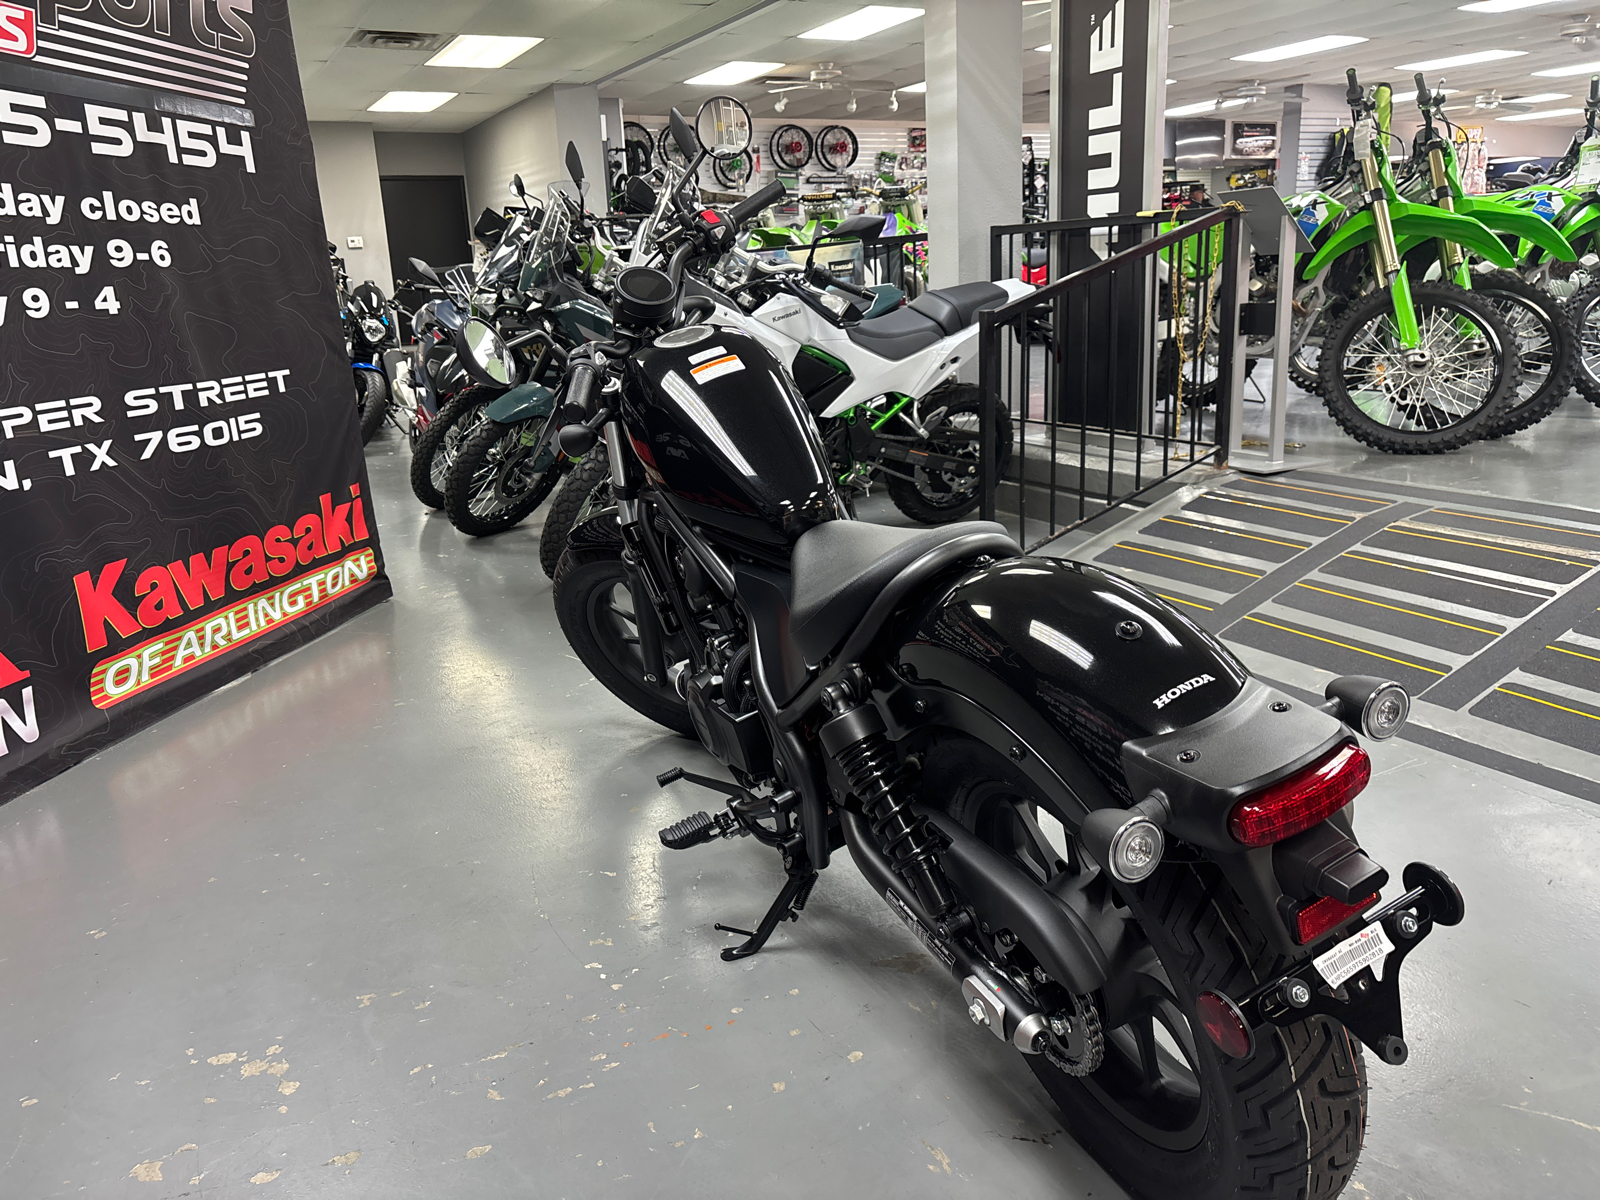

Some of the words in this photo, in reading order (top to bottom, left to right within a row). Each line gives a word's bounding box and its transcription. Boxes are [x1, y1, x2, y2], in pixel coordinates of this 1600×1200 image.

[0, 89, 256, 174] 5-5454
[80, 191, 202, 226] closed
[106, 238, 172, 268] 9-6
[22, 287, 51, 319] 9
[94, 285, 121, 315] 4
[772, 308, 802, 323] Kawasaki
[0, 395, 105, 439] PER
[123, 368, 291, 418] STREET
[48, 439, 118, 477] TX
[134, 412, 263, 460] 76015
[74, 483, 370, 652] Kawasaki
[105, 648, 164, 697] OF
[174, 556, 368, 668] ARLINGTON
[1152, 673, 1216, 710] HONDA
